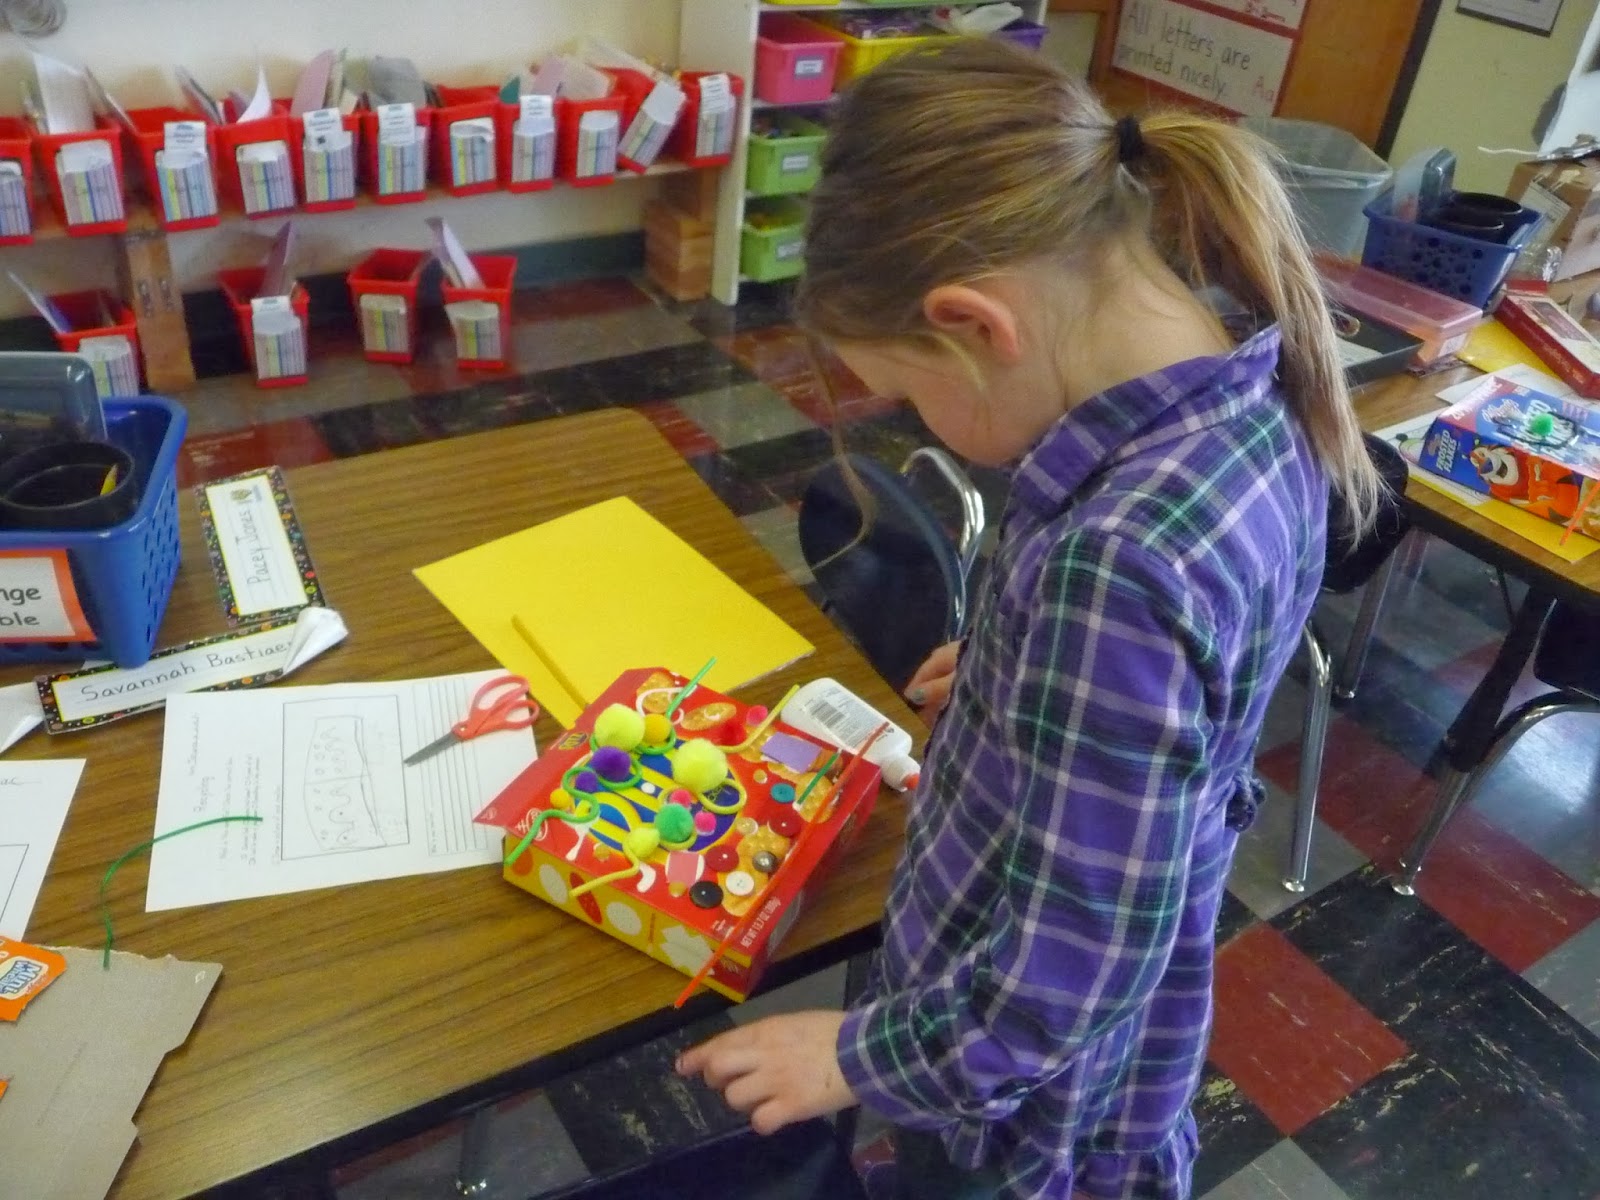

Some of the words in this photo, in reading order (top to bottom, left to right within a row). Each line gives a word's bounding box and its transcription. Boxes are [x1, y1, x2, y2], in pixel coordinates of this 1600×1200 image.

[1161, 13, 1214, 57] letters
[1221, 45, 1250, 70] are
[1180, 64, 1227, 100] nicely
[1436, 429, 1450, 470] FROSTED
[1443, 437, 1457, 473] FLAKES
[235, 508, 259, 545] Jones
[81, 662, 195, 701] Savannah
[4, 963, 41, 994] Mini
